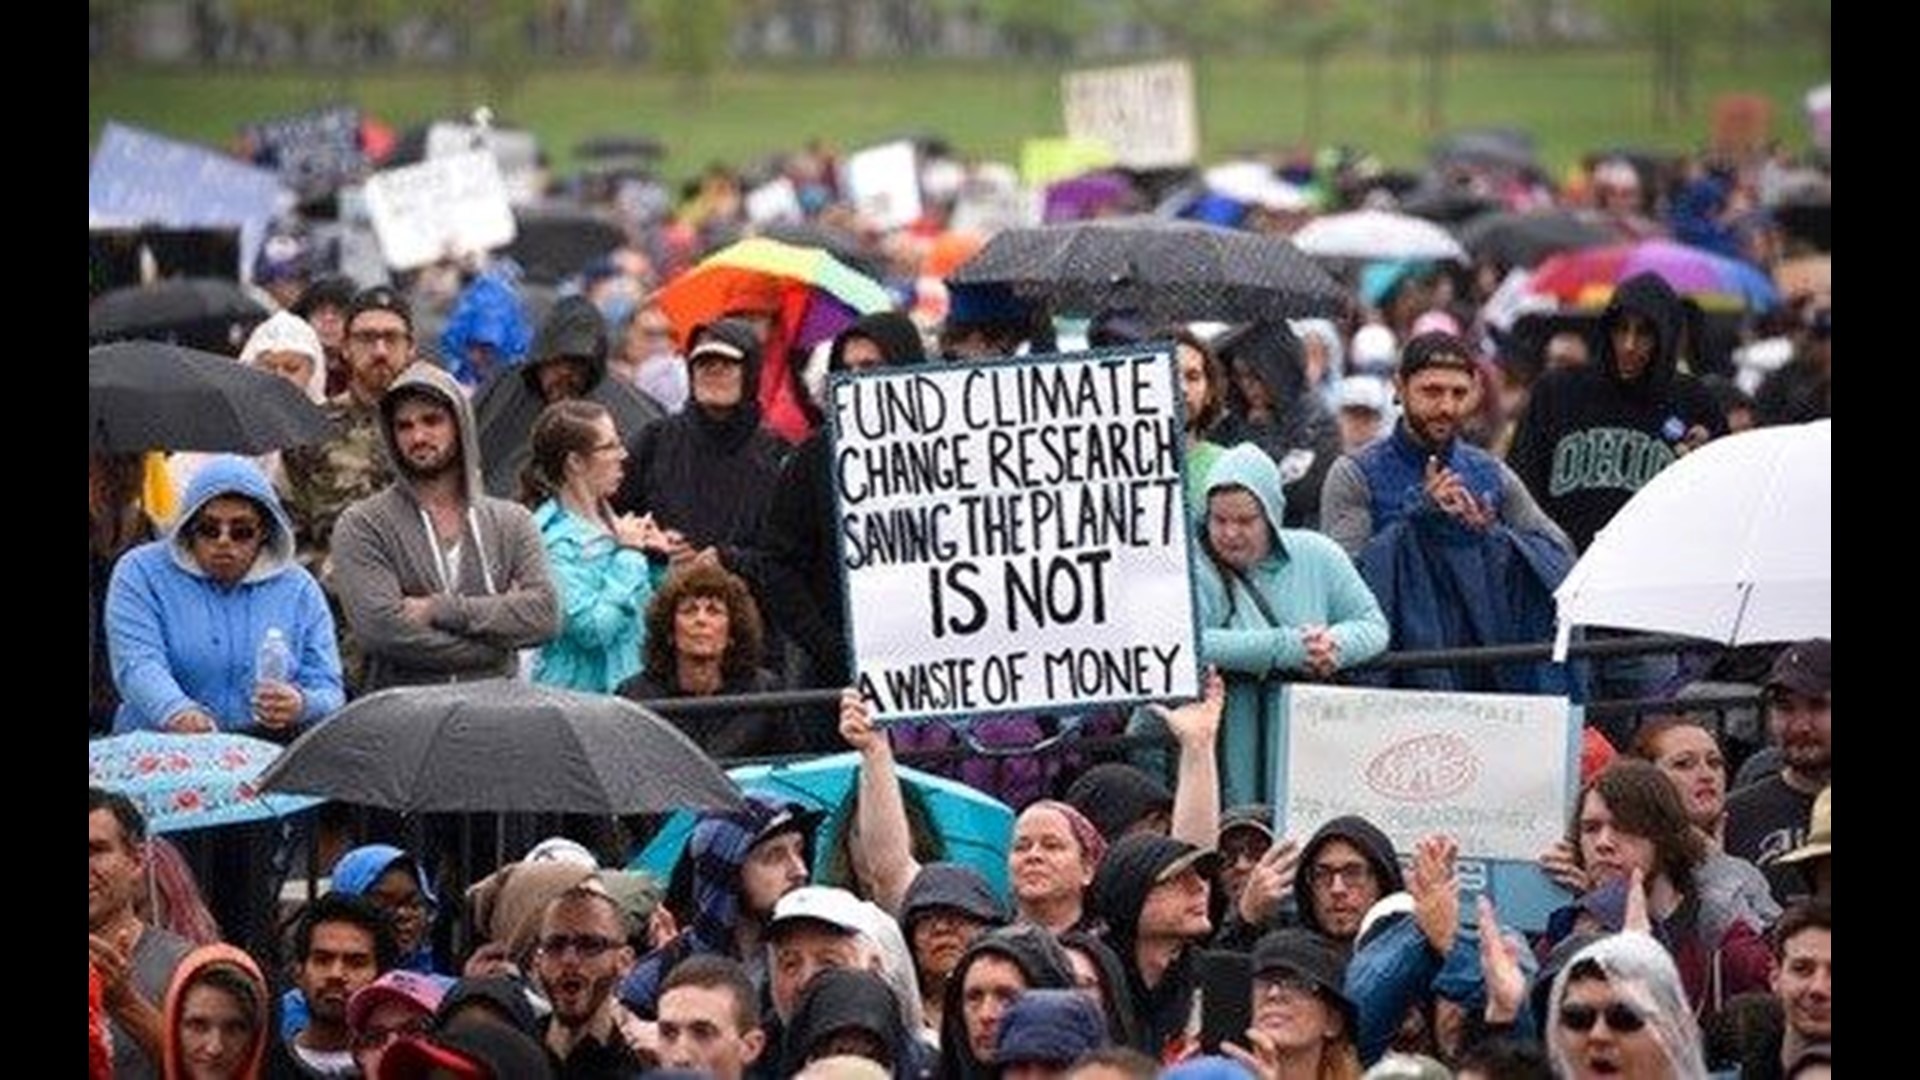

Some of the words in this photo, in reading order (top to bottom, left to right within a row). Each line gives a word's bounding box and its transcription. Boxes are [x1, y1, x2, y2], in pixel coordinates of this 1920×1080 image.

[834, 375, 946, 440] FUND
[963, 356, 1159, 429] CLIMATE
[838, 434, 976, 505] CHANGE
[988, 418, 1180, 489] RESEARCH
[843, 503, 958, 570] SAVING
[959, 495, 1024, 557] THE
[1030, 478, 1180, 551] PLANET
[929, 561, 988, 638] IS
[1003, 551, 1111, 632] NOT
[857, 672, 886, 713] A
[884, 659, 976, 711] WASTE
[982, 652, 1028, 705] OF
[1044, 644, 1181, 700] MONEY
